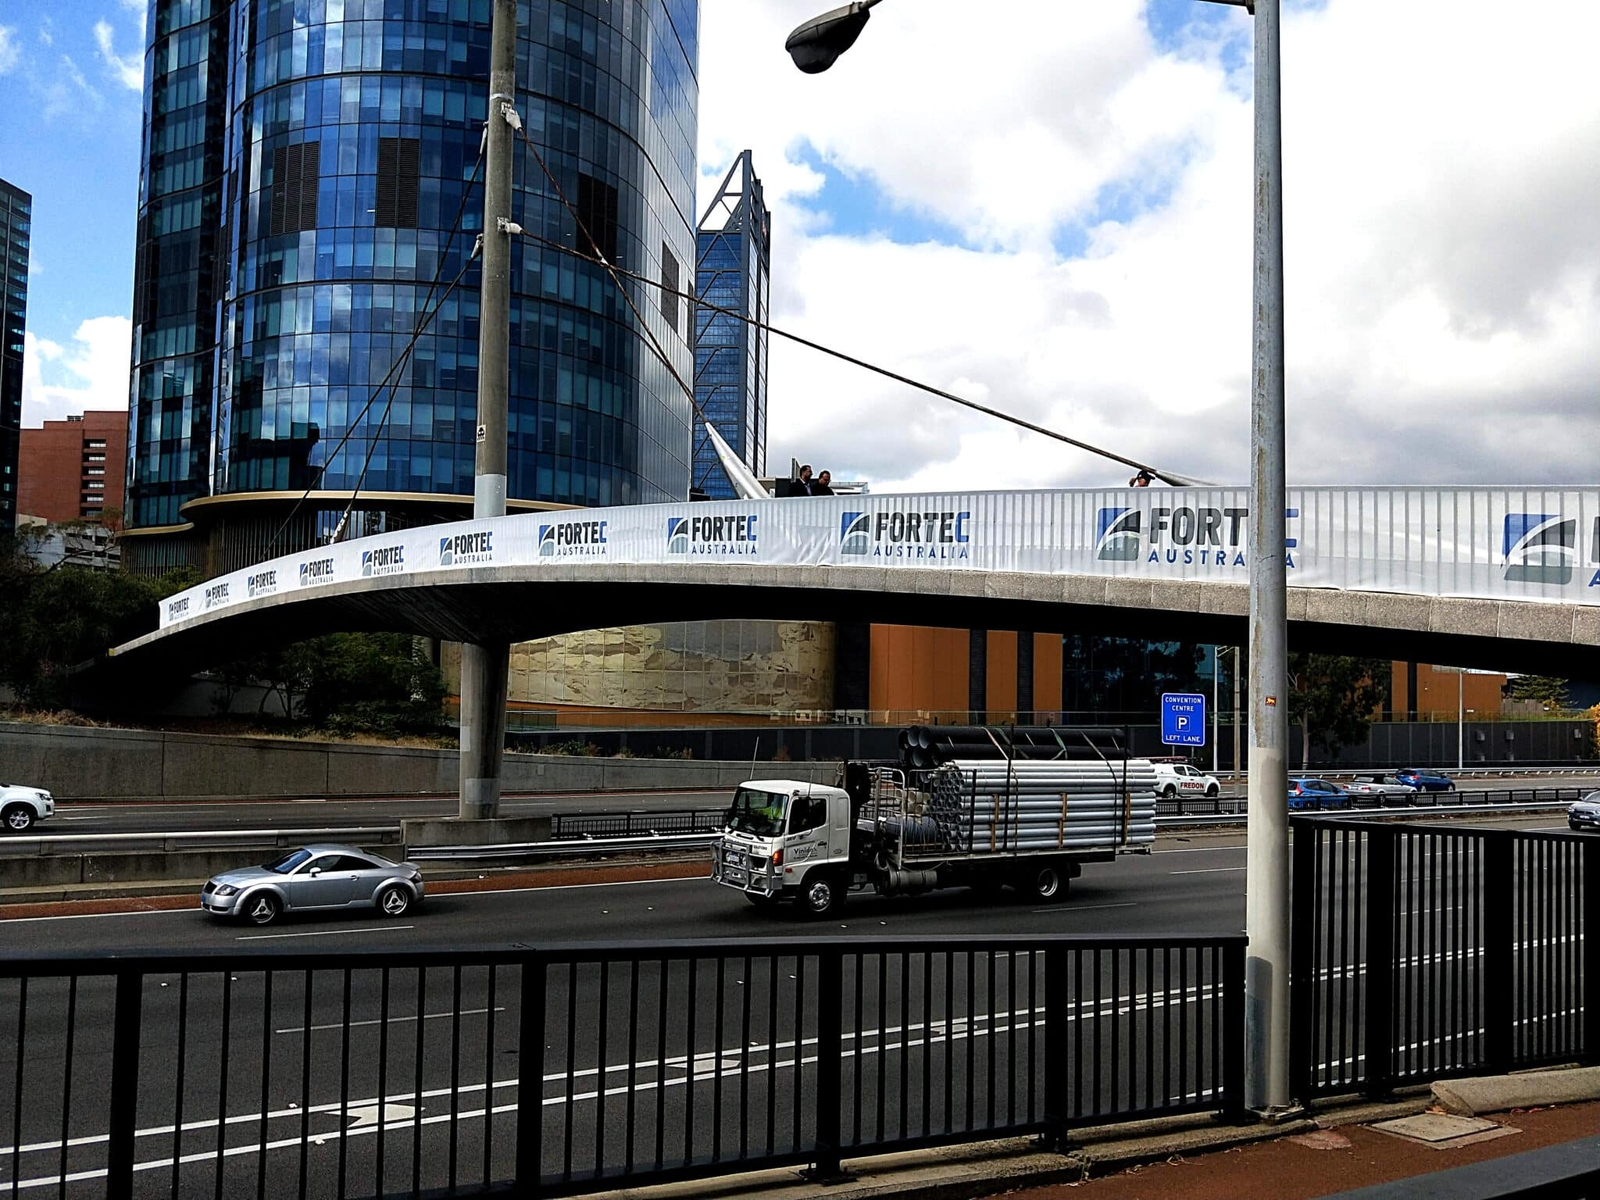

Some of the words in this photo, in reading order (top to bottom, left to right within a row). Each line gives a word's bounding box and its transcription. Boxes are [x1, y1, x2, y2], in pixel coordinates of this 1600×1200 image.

[557, 521, 607, 545] FORTEC
[692, 515, 757, 542] FORTEC
[875, 511, 970, 542] FORTEC
[454, 531, 492, 555] FORTEC
[557, 545, 606, 555] AUSTRALIA
[691, 544, 757, 555] AUSTRALIA
[873, 545, 968, 559] AUSTRALIA
[373, 545, 404, 566] FORTEC
[454, 554, 492, 564] AUSTRALIA
[1148, 549, 1295, 569] AUSTRAA
[309, 558, 333, 577] FORTEC
[256, 570, 276, 588] FORTEC
[212, 583, 229, 600] FORTEC
[1165, 696, 1202, 704] CONVENTION
